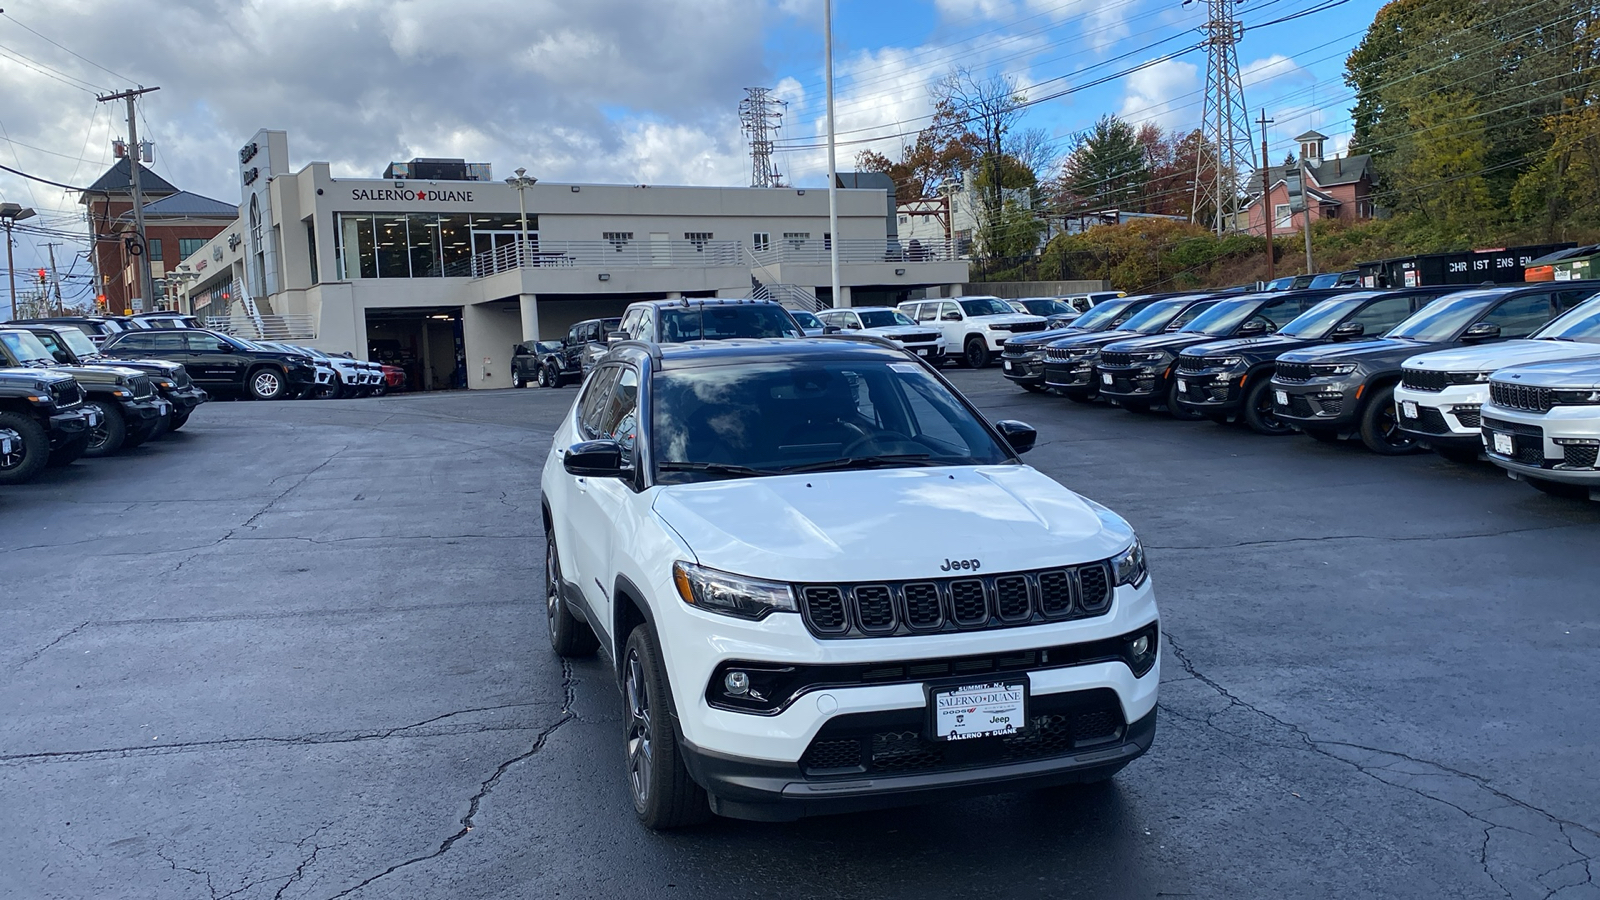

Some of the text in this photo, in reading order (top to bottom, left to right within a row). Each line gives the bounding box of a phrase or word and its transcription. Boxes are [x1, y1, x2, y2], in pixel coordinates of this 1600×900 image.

[352, 189, 474, 202] SALERNO DUANE
[940, 558, 981, 573] Jeep
[938, 691, 1021, 708] SALERNO DUANE
[989, 715, 1010, 724] Jeep
[946, 727, 1018, 742] SALERNO DUANE
